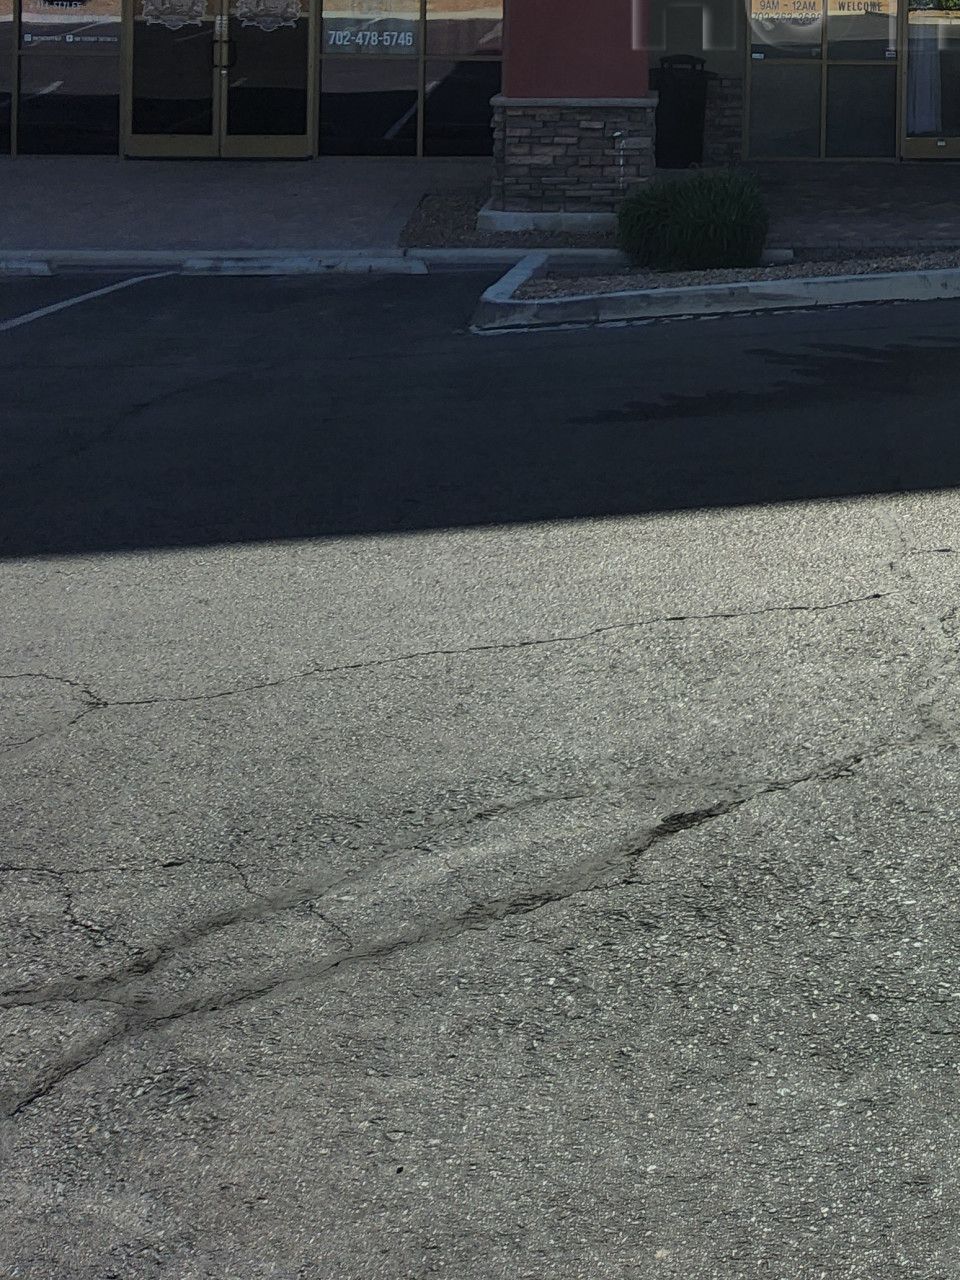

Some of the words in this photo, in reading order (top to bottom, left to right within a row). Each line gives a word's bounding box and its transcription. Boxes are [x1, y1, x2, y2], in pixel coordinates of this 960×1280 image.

[759, 0, 780, 11] 9AM
[792, 0, 816, 11] 12AM
[838, 1, 882, 12] WELCOME
[328, 30, 414, 46] 702-478-5746
